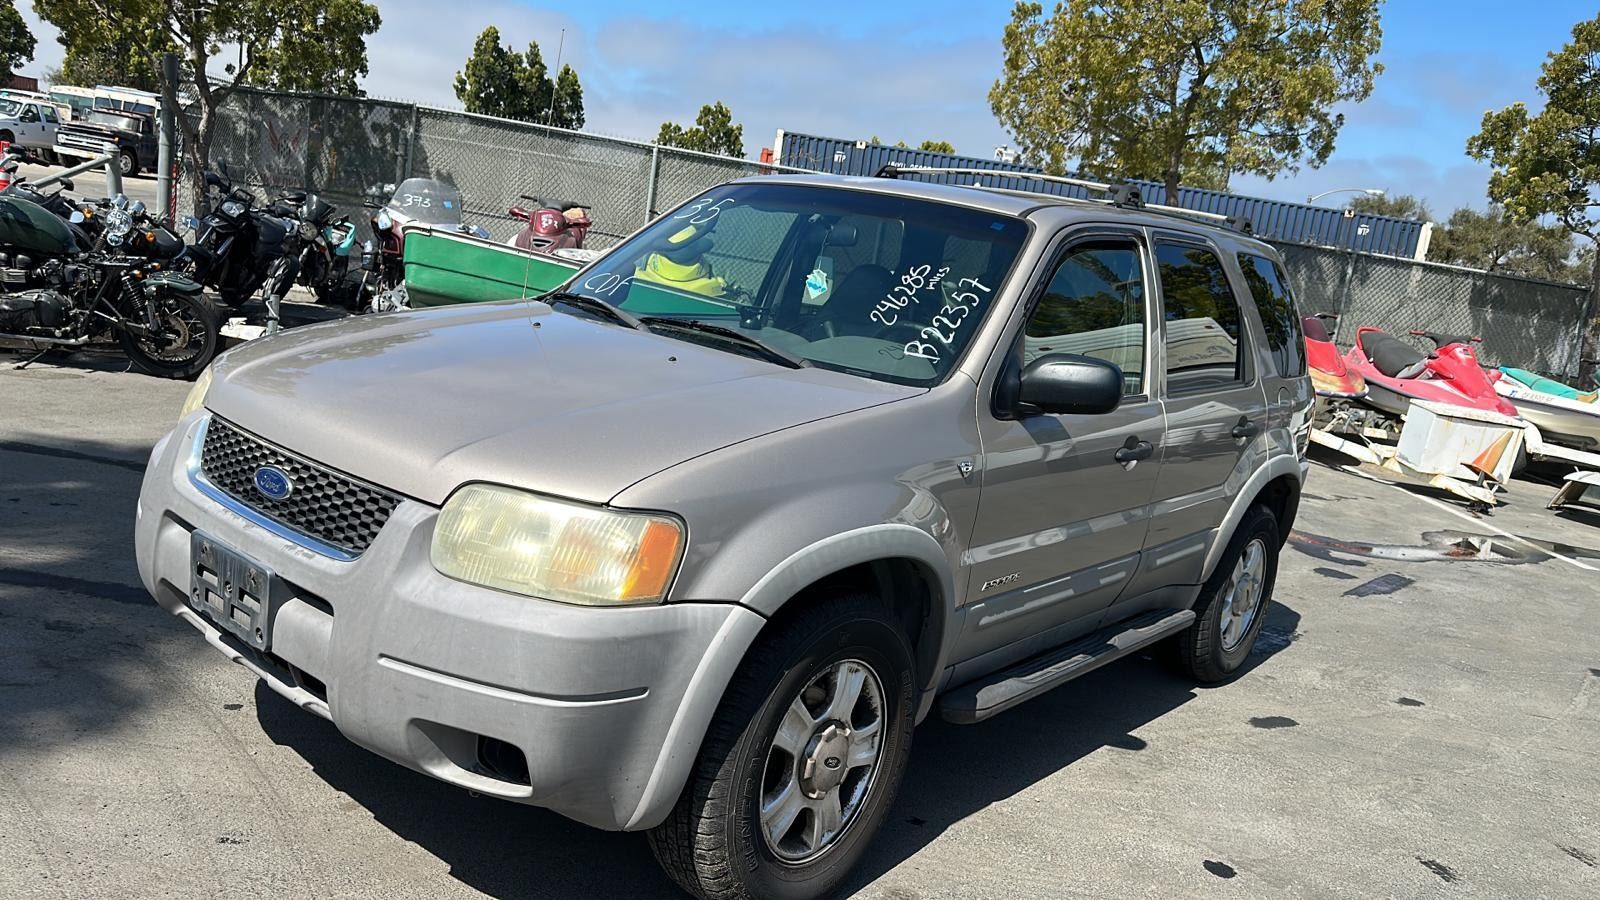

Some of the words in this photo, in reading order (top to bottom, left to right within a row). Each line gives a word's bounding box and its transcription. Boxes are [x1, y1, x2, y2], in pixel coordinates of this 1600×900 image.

[673, 198, 736, 225] 35
[583, 272, 635, 297] CDF
[903, 277, 992, 364] B22357
